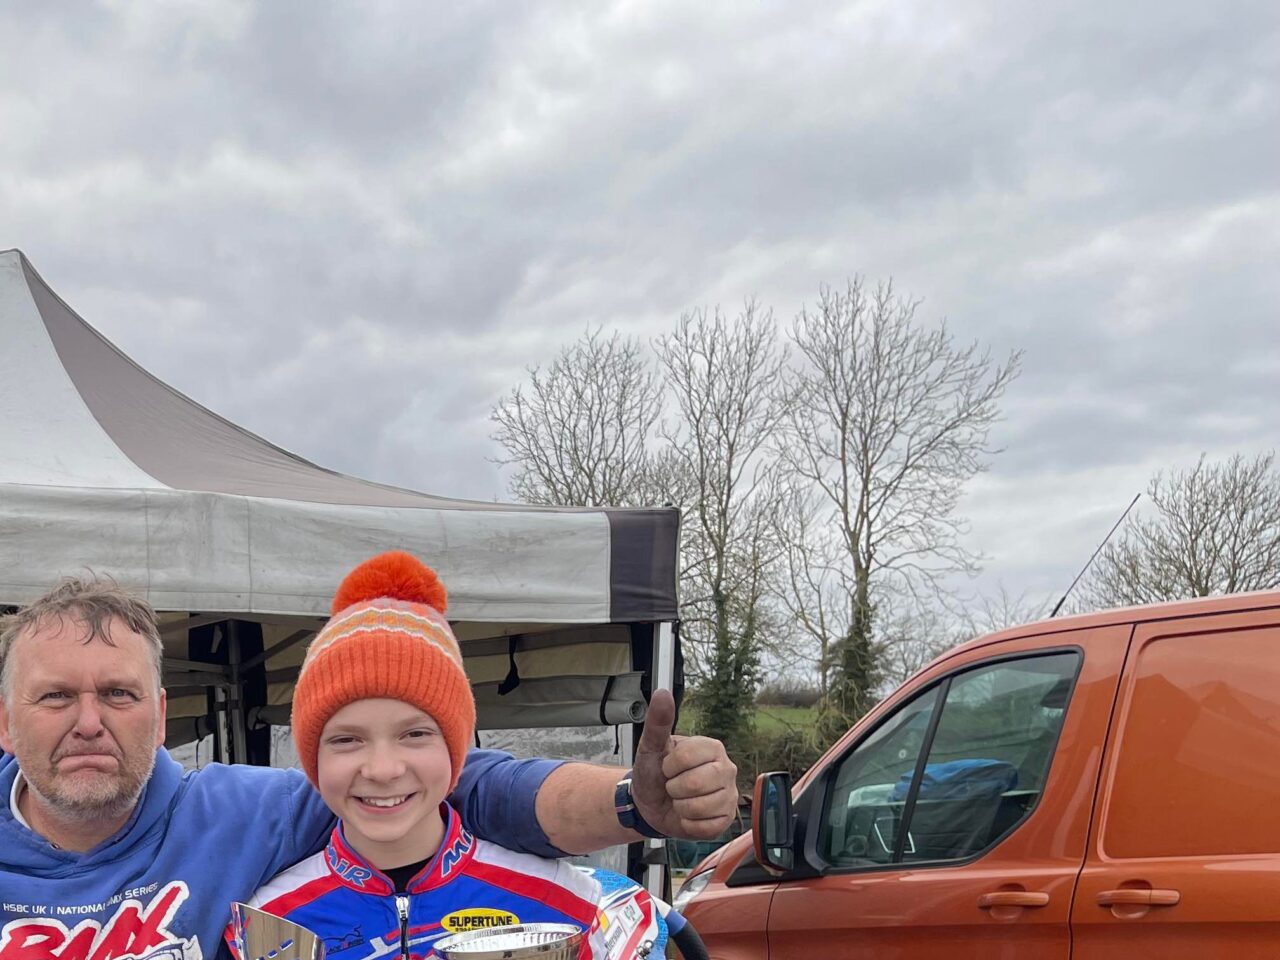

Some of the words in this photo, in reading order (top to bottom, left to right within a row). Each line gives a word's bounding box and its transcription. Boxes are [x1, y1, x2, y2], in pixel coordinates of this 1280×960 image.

[3, 903, 29, 914] HSBC
[32, 905, 47, 914] UK
[125, 882, 159, 899] SERIES
[449, 915, 513, 928] SUPERTUNE
